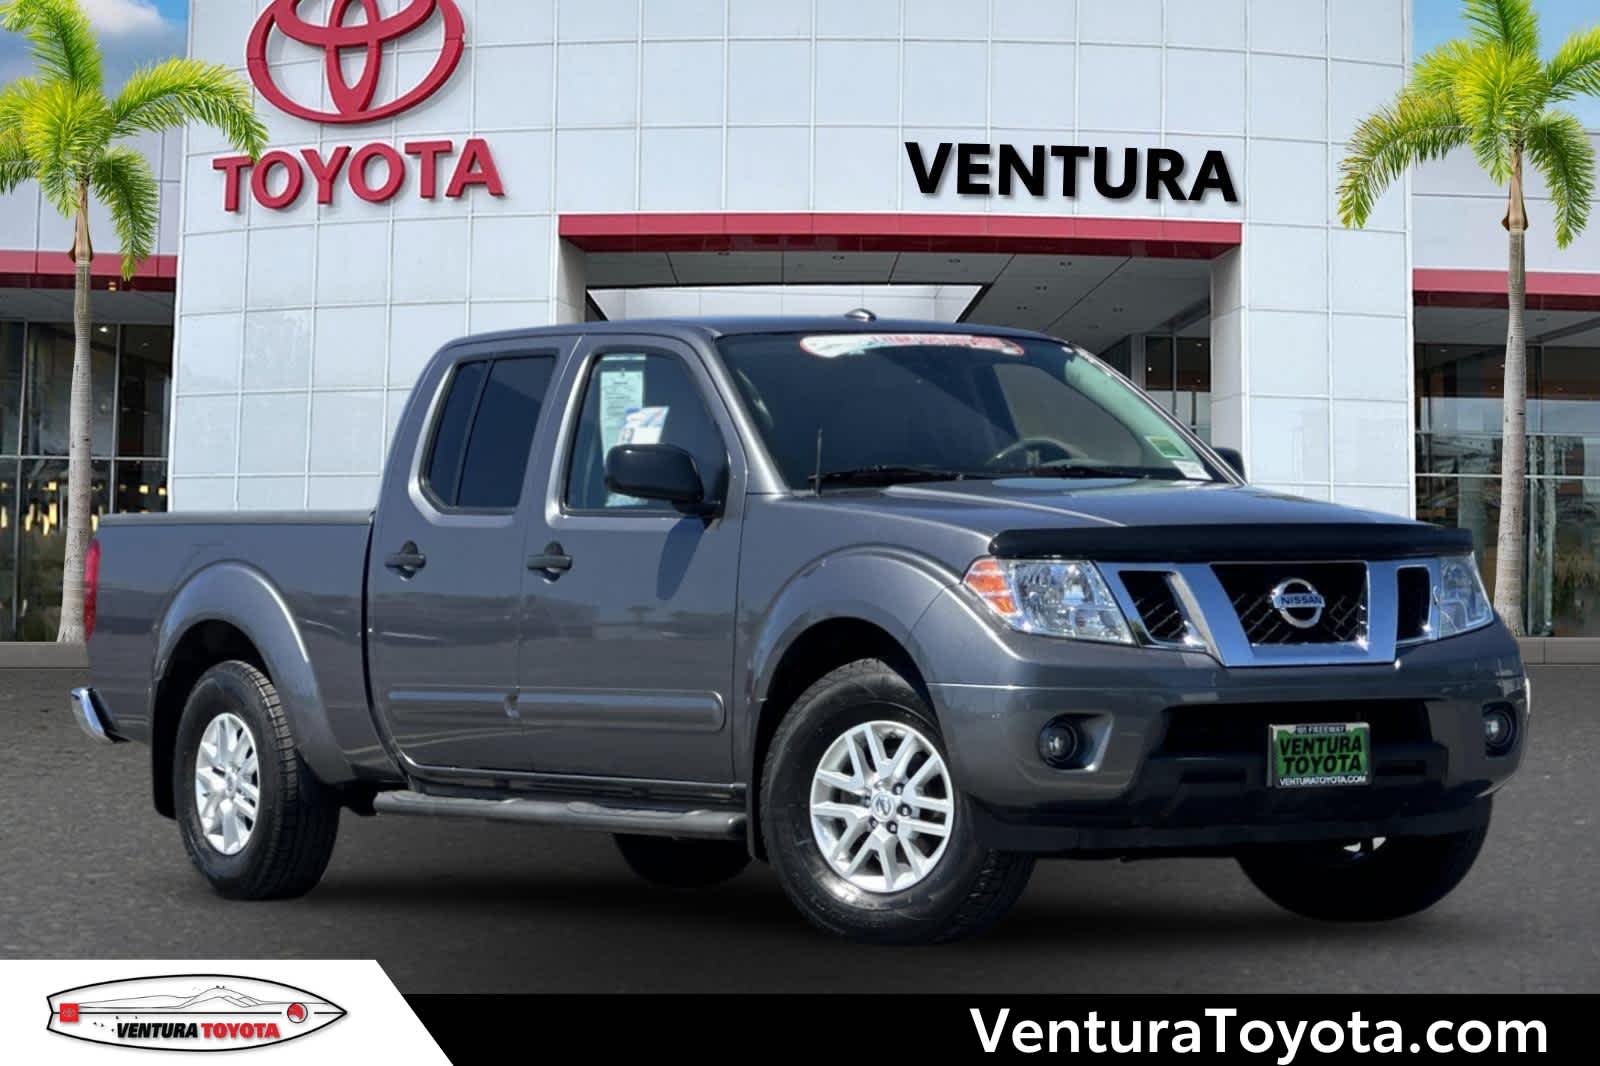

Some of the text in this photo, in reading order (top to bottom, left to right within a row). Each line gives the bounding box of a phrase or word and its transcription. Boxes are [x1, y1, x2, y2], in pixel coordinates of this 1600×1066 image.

[212, 138, 505, 212] TOYOTA
[904, 141, 1238, 202] VENTURA
[1281, 595, 1322, 604] NISSAN
[1280, 736, 1362, 756] VENTURA
[1282, 754, 1361, 775] TOYOTA
[1280, 775, 1366, 786] VENTURATOYOTA.COM
